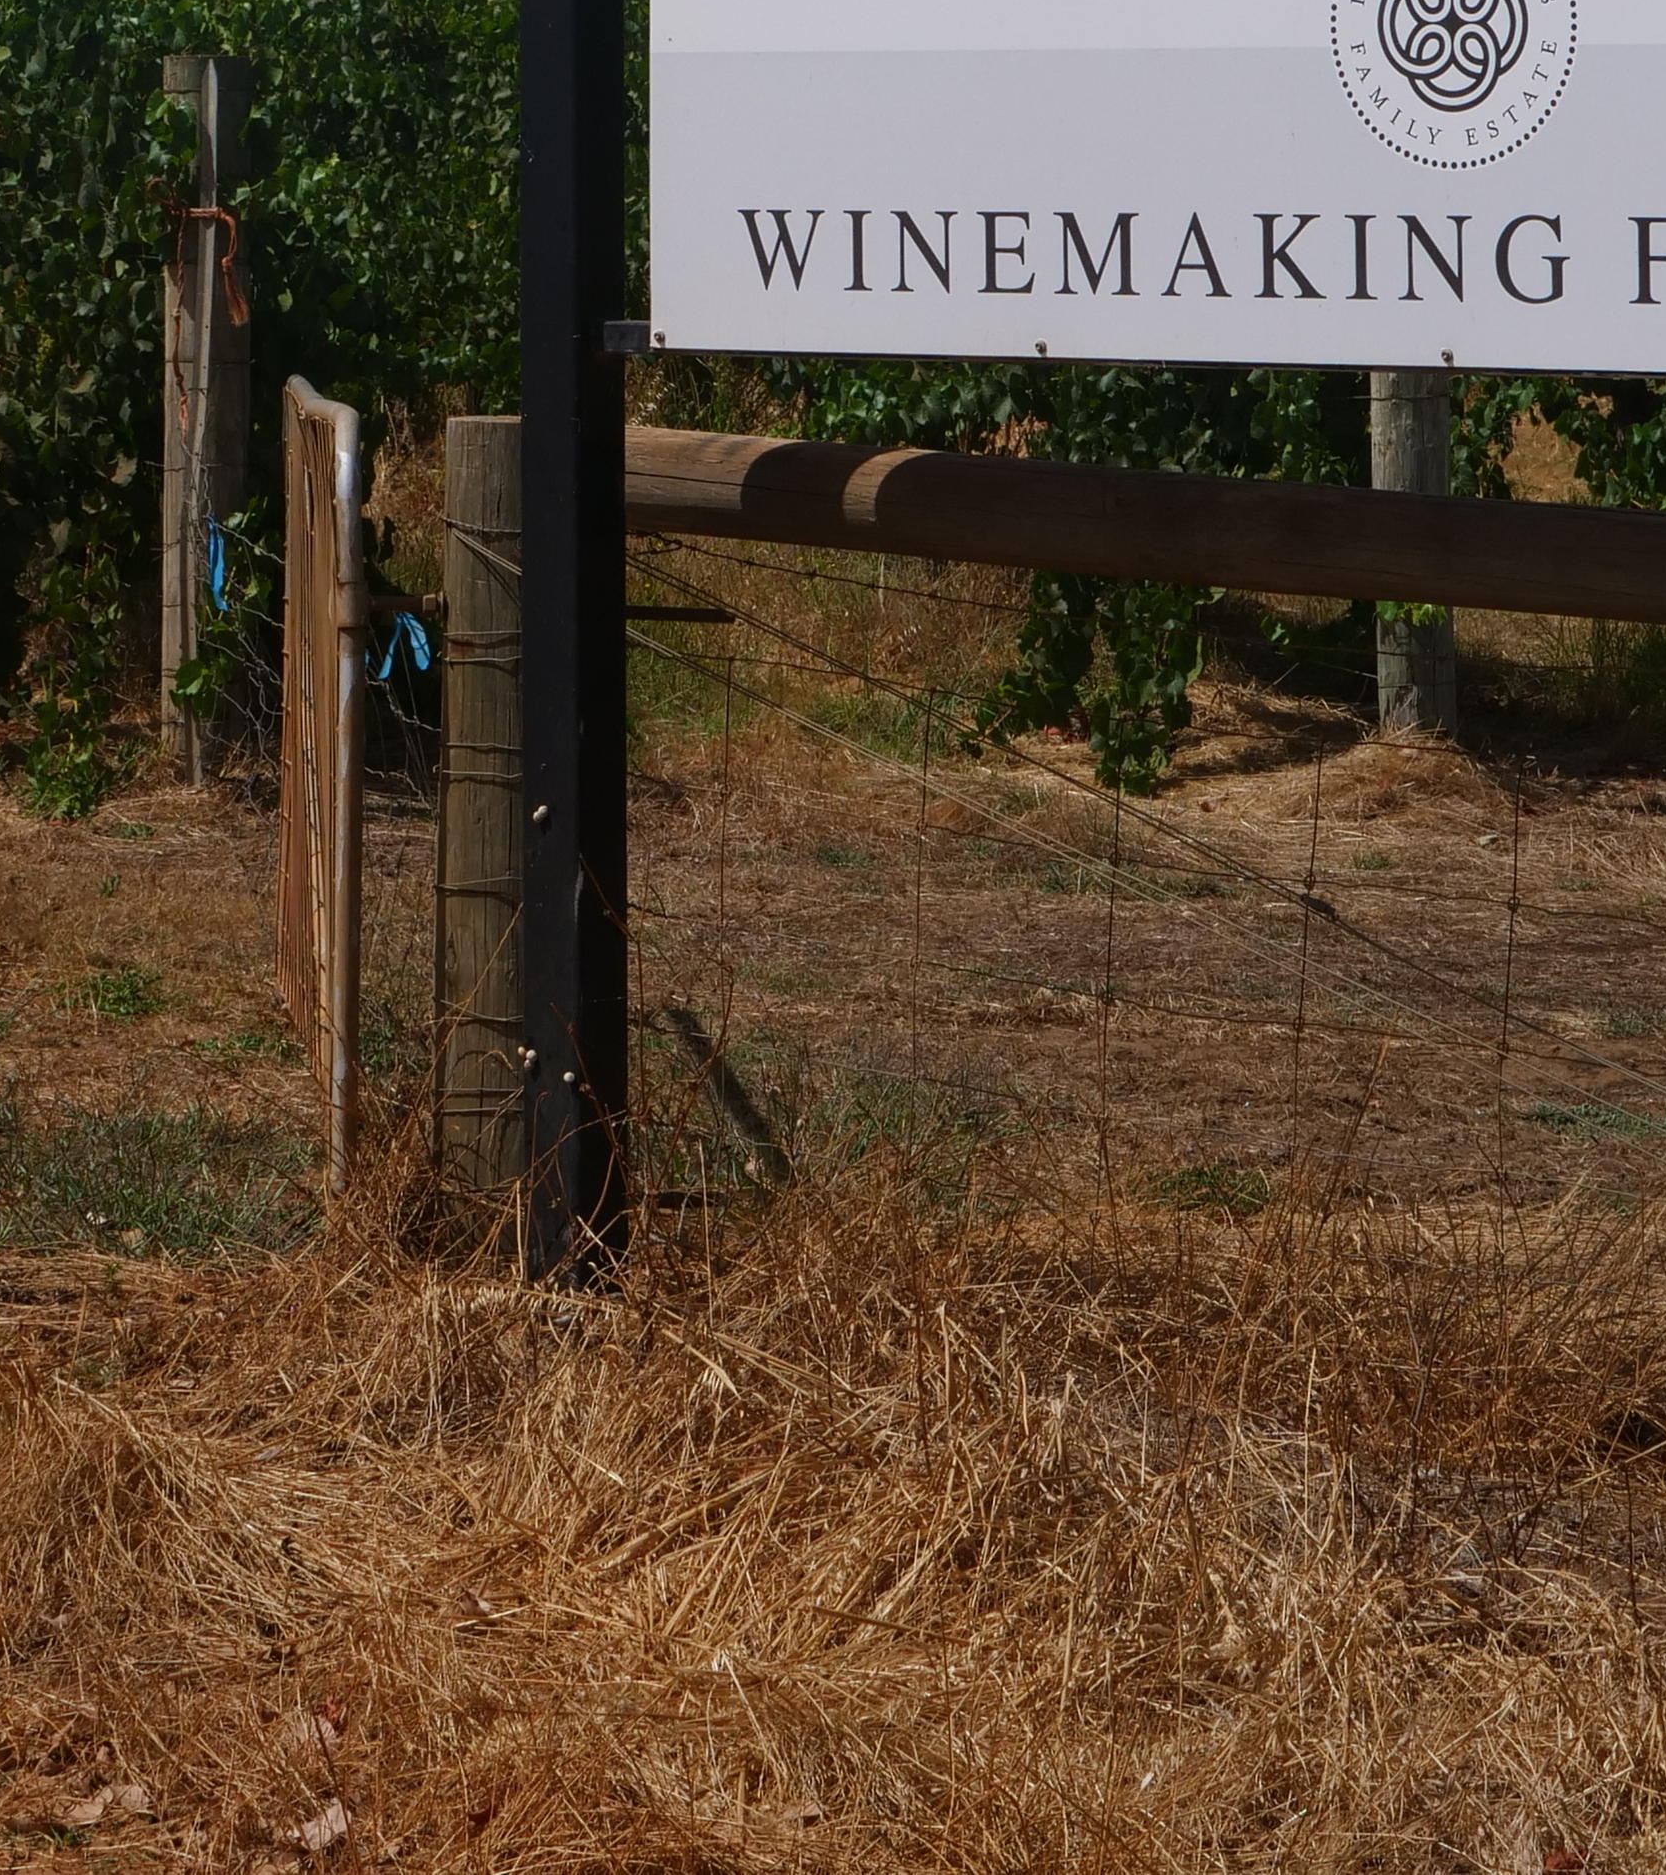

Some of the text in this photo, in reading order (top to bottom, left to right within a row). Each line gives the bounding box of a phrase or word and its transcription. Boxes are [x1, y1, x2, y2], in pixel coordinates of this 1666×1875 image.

[1350, 40, 1558, 147] FAMILY ESTATE
[738, 209, 1571, 305] WINEMAKING
